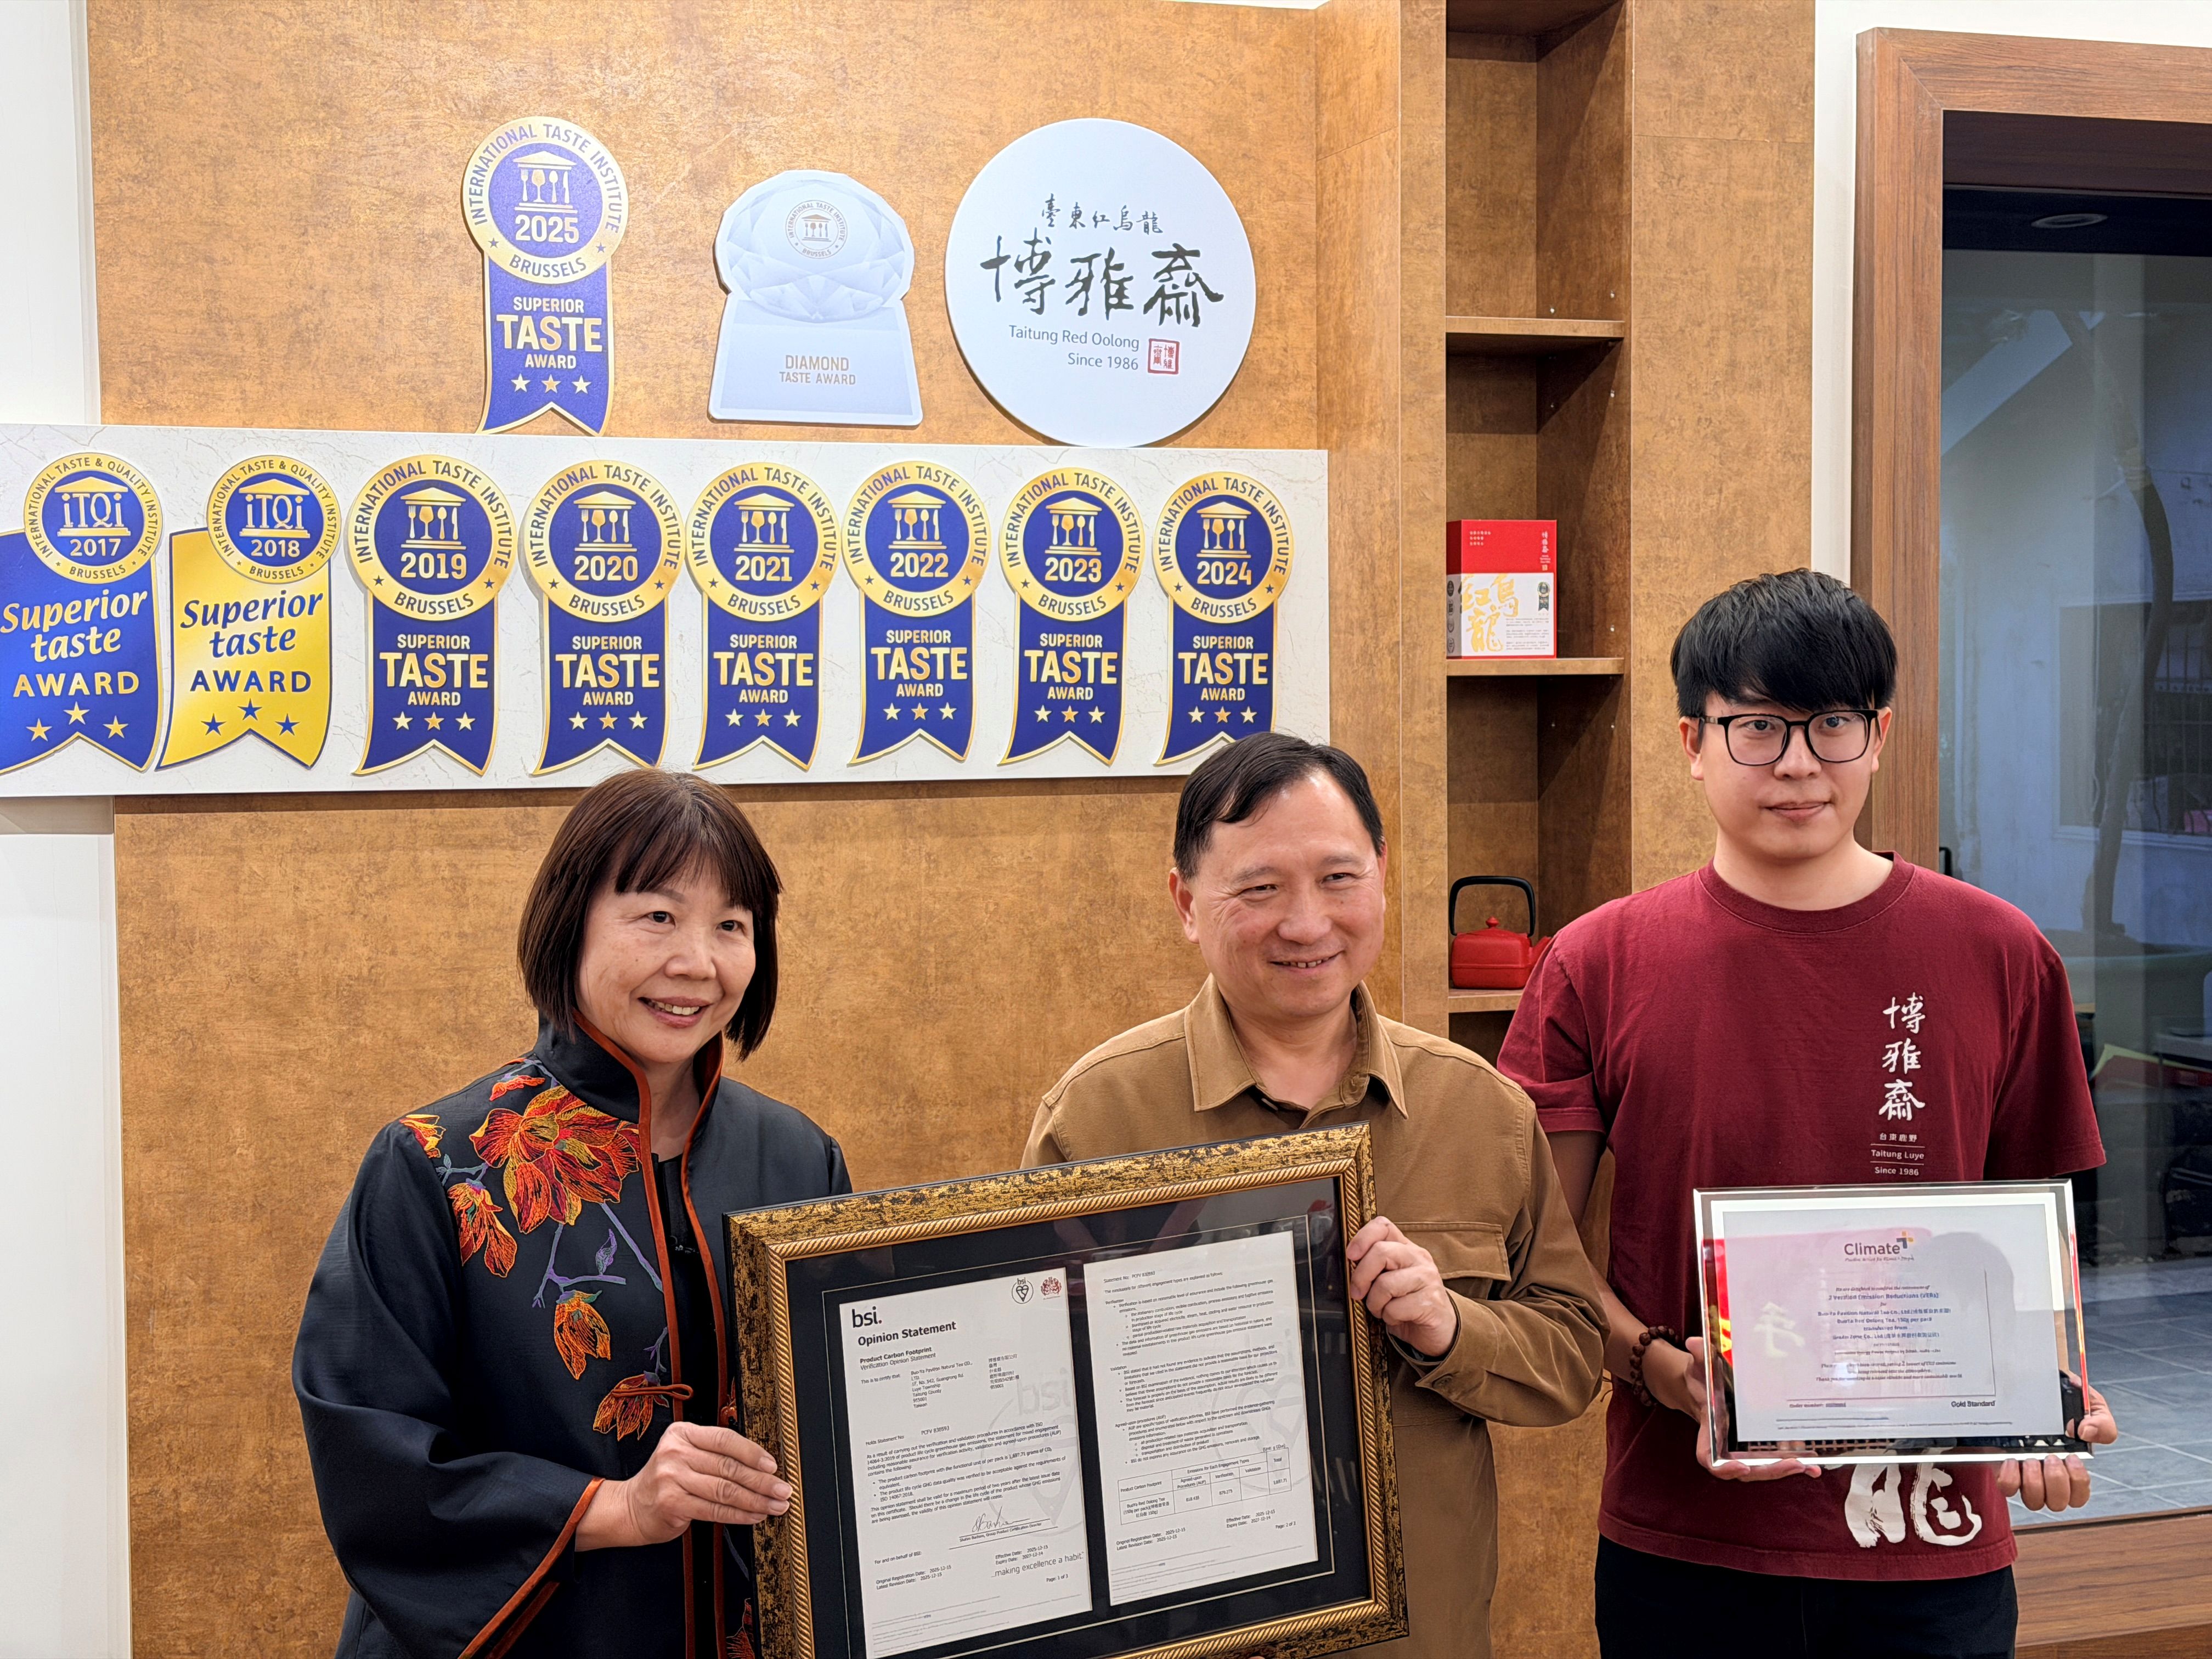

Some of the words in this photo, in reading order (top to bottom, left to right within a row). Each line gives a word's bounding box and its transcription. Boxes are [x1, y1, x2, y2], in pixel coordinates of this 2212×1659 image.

[469, 124, 537, 225] INTERNATIONAL
[543, 123, 591, 153] TASTE
[590, 150, 622, 233] INSTITUTE
[515, 215, 579, 243] 2025
[788, 202, 814, 238] INTERNATIONAL
[816, 202, 834, 213] TASTE
[833, 212, 845, 241] INSTITUTE
[802, 248, 832, 257] BRUSSELS
[509, 254, 586, 278] BRUSSELS
[513, 296, 584, 313] SUPERIOR
[496, 314, 602, 352] TASTE
[1008, 324, 1058, 345] Taitung
[1062, 329, 1087, 345] Red
[1091, 334, 1139, 352] Oolong
[524, 354, 577, 369] AWARD
[785, 354, 849, 371] DIAMOND
[1068, 353, 1103, 368] Since
[1108, 356, 1138, 370] 1986
[779, 371, 811, 383] TASTE
[816, 373, 856, 385] AWARD
[28, 473, 57, 557] INTERNATIONAL
[55, 457, 91, 472] TASTE
[95, 458, 103, 467] &
[107, 461, 150, 501] QUALITY
[138, 498, 158, 557] INSTITUTE
[61, 492, 121, 528] iTQi
[212, 475, 241, 557] INTERNATIONAL
[239, 459, 274, 473] TASTE
[279, 460, 286, 470] &
[290, 463, 331, 500] QUALITY
[317, 499, 336, 560] INSTITUTE
[245, 494, 303, 530] iTQi
[354, 461, 427, 563] INTERNATIONAL
[432, 460, 482, 489] TASTE
[479, 486, 512, 569] INSTITUTE
[529, 465, 598, 567] INTERNATIONAL
[603, 464, 651, 492] TASTE
[649, 488, 681, 570] INSTITUTE
[848, 466, 911, 565] INTERNATIONAL
[916, 465, 960, 492] TASTE
[958, 489, 987, 567] INSTITUTE
[691, 467, 758, 567] INTERNATIONAL
[764, 467, 809, 495] TASTE
[807, 492, 837, 572] INSTITUTE
[1006, 473, 1069, 568] INTERNATIONAL
[1074, 472, 1116, 500] TASTE
[1114, 496, 1141, 574] INSTITUTE
[1158, 478, 1218, 572] INTERNATIONAL
[1223, 477, 1265, 503] TASTE
[1262, 500, 1289, 575] INSTITUTE
[70, 538, 121, 557] 2017
[251, 539, 300, 557] 2018
[69, 564, 127, 580] BRUSSELS
[249, 565, 304, 580] BRUSSELS
[400, 552, 466, 579] 2019
[574, 555, 638, 581] 2020
[735, 555, 793, 582] 2021
[890, 552, 949, 578] 2022
[1045, 557, 1102, 583] 2023
[1197, 561, 1252, 585] 2024
[1, 589, 148, 633] Superior
[179, 589, 324, 629] Superior
[394, 591, 474, 615] BRUSSELS
[568, 594, 645, 616] BRUSSELS
[727, 592, 801, 616] BRUSSELS
[883, 590, 954, 611] BRUSSELS
[1038, 594, 1107, 616] BRUSSELS
[1190, 597, 1257, 618] BRUSSELS
[31, 626, 121, 663] taste
[209, 625, 296, 658] taste
[397, 634, 470, 650] SUPERIOR
[572, 635, 642, 650] SUPERIOR
[730, 634, 797, 648] SUPERIOR
[886, 629, 951, 644] SUPERIOR
[1039, 633, 1103, 648] SUPERIOR
[1193, 635, 1254, 650] SUPERIOR
[379, 652, 488, 689] TASTE
[555, 653, 660, 689] TASTE
[713, 651, 814, 686] TASTE
[871, 646, 968, 680] TASTE
[1024, 650, 1118, 684] TASTE
[1177, 652, 1268, 685] TASTE
[13, 671, 139, 698] AWARD
[190, 669, 311, 693] AWARD
[895, 683, 944, 697] AWARD
[407, 691, 461, 706] AWARD
[582, 691, 634, 706] AWARD
[738, 689, 788, 703] AWARD
[1047, 686, 1094, 701] AWARD
[1200, 687, 1245, 702] AWARD
[1871, 1149, 1902, 1160] Taitung
[1904, 1151, 1925, 1160] Luye
[1875, 1166, 1897, 1175] Since
[1899, 1167, 1919, 1176] 1986
[1844, 1243, 1900, 1255] Climate
[852, 1306, 882, 1328] bsi.
[858, 1333, 899, 1346] Opinion
[902, 1322, 956, 1339] Statement
[861, 1362, 888, 1370] Verification
[911, 1353, 936, 1361] Statement
[906, 1347, 932, 1356] Footprint
[892, 1573, 915, 1581] Registration
[1022, 1559, 1057, 1571] excellence
